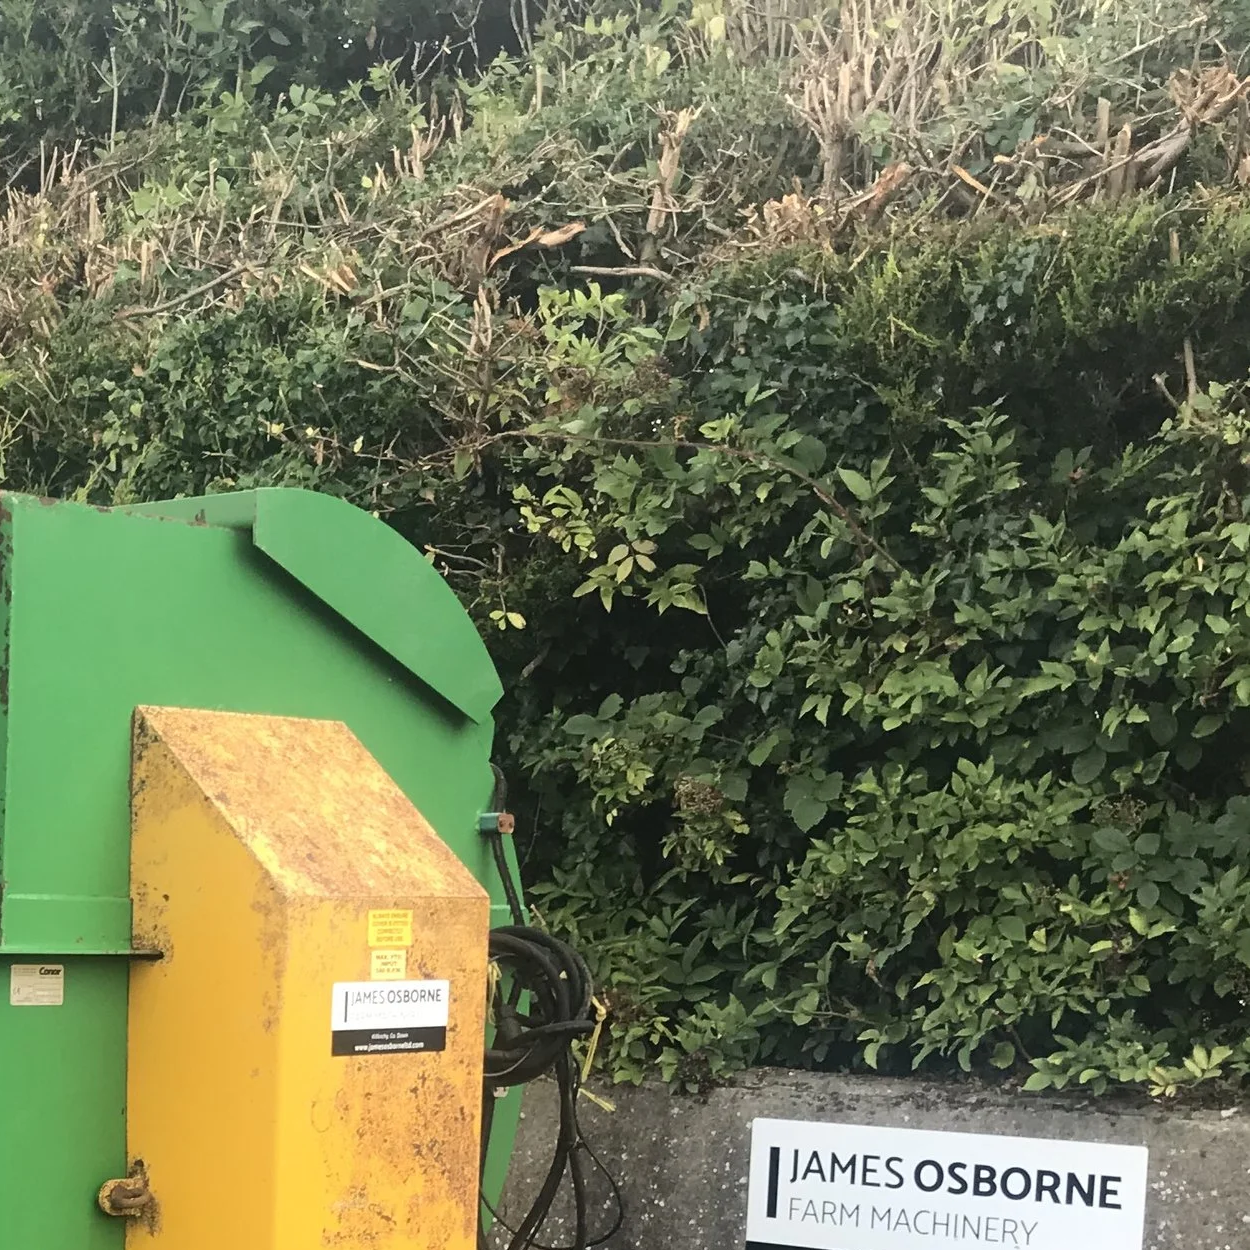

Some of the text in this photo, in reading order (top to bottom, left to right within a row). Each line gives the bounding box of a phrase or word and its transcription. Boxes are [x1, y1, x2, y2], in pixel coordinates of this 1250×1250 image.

[351, 988, 442, 1006] JAMES OSBORNE
[790, 1149, 1122, 1210] JAMES OSBORNE
[788, 1198, 1039, 1246] FARM MACHINERY
